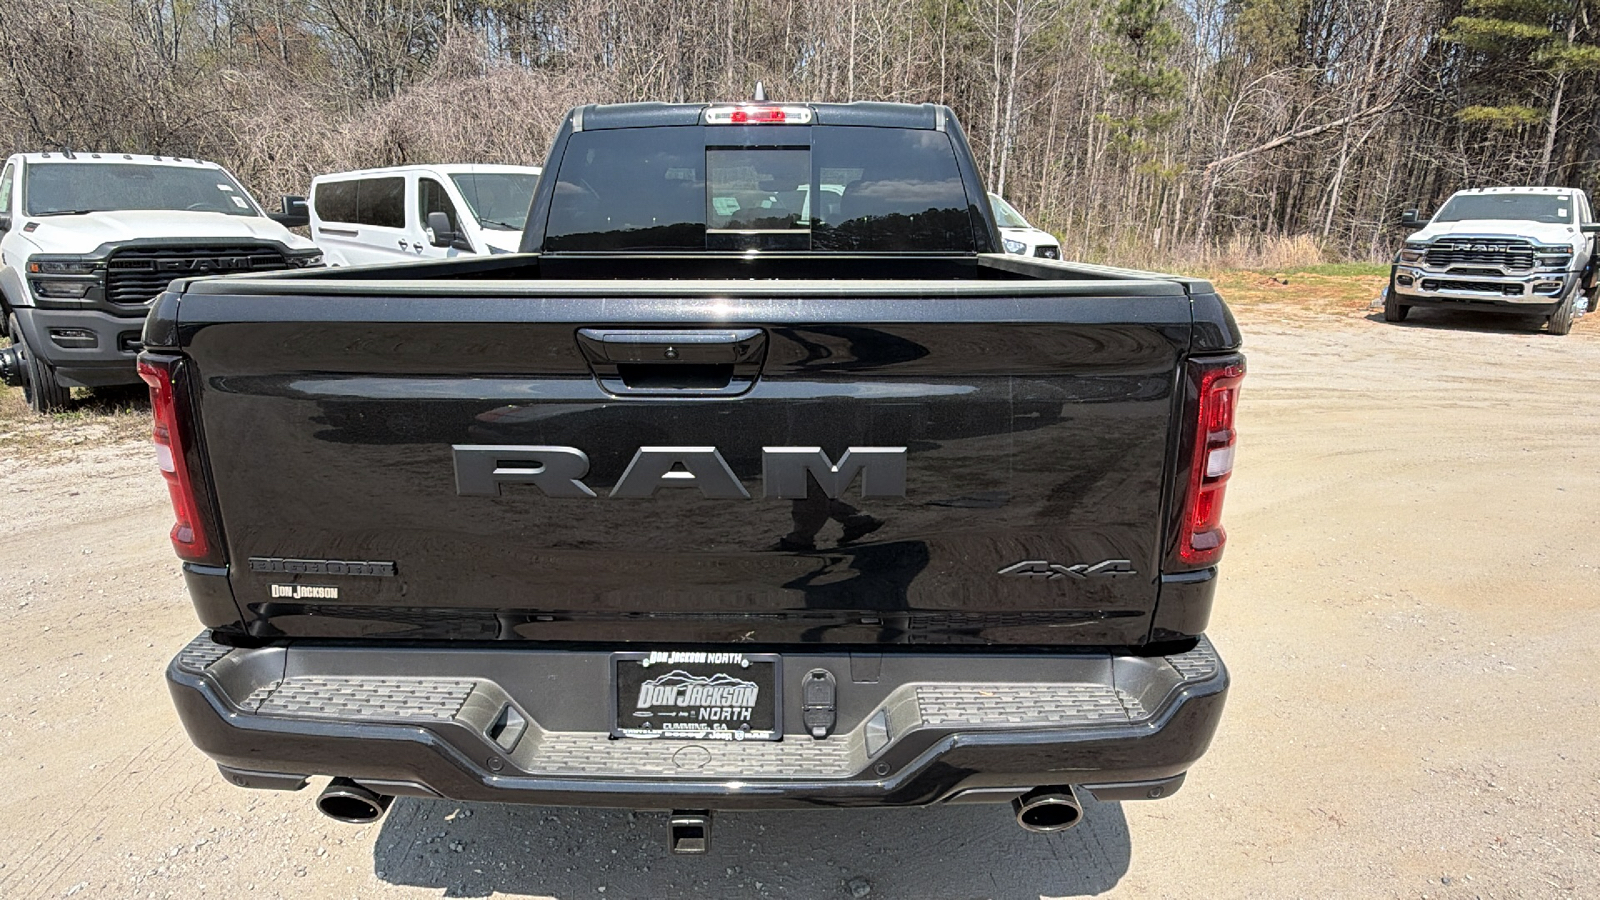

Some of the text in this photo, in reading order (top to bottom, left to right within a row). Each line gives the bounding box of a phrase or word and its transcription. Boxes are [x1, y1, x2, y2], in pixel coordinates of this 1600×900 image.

[1453, 243, 1507, 253] RAM
[154, 257, 249, 271] RAM
[451, 444, 908, 499] RAM
[271, 584, 338, 599] DON JACKSON
[650, 651, 742, 664] DON JACKSON NORTH
[637, 684, 759, 709] DON JACKSON
[699, 708, 753, 721] NORTH
[713, 723, 728, 731] GA
